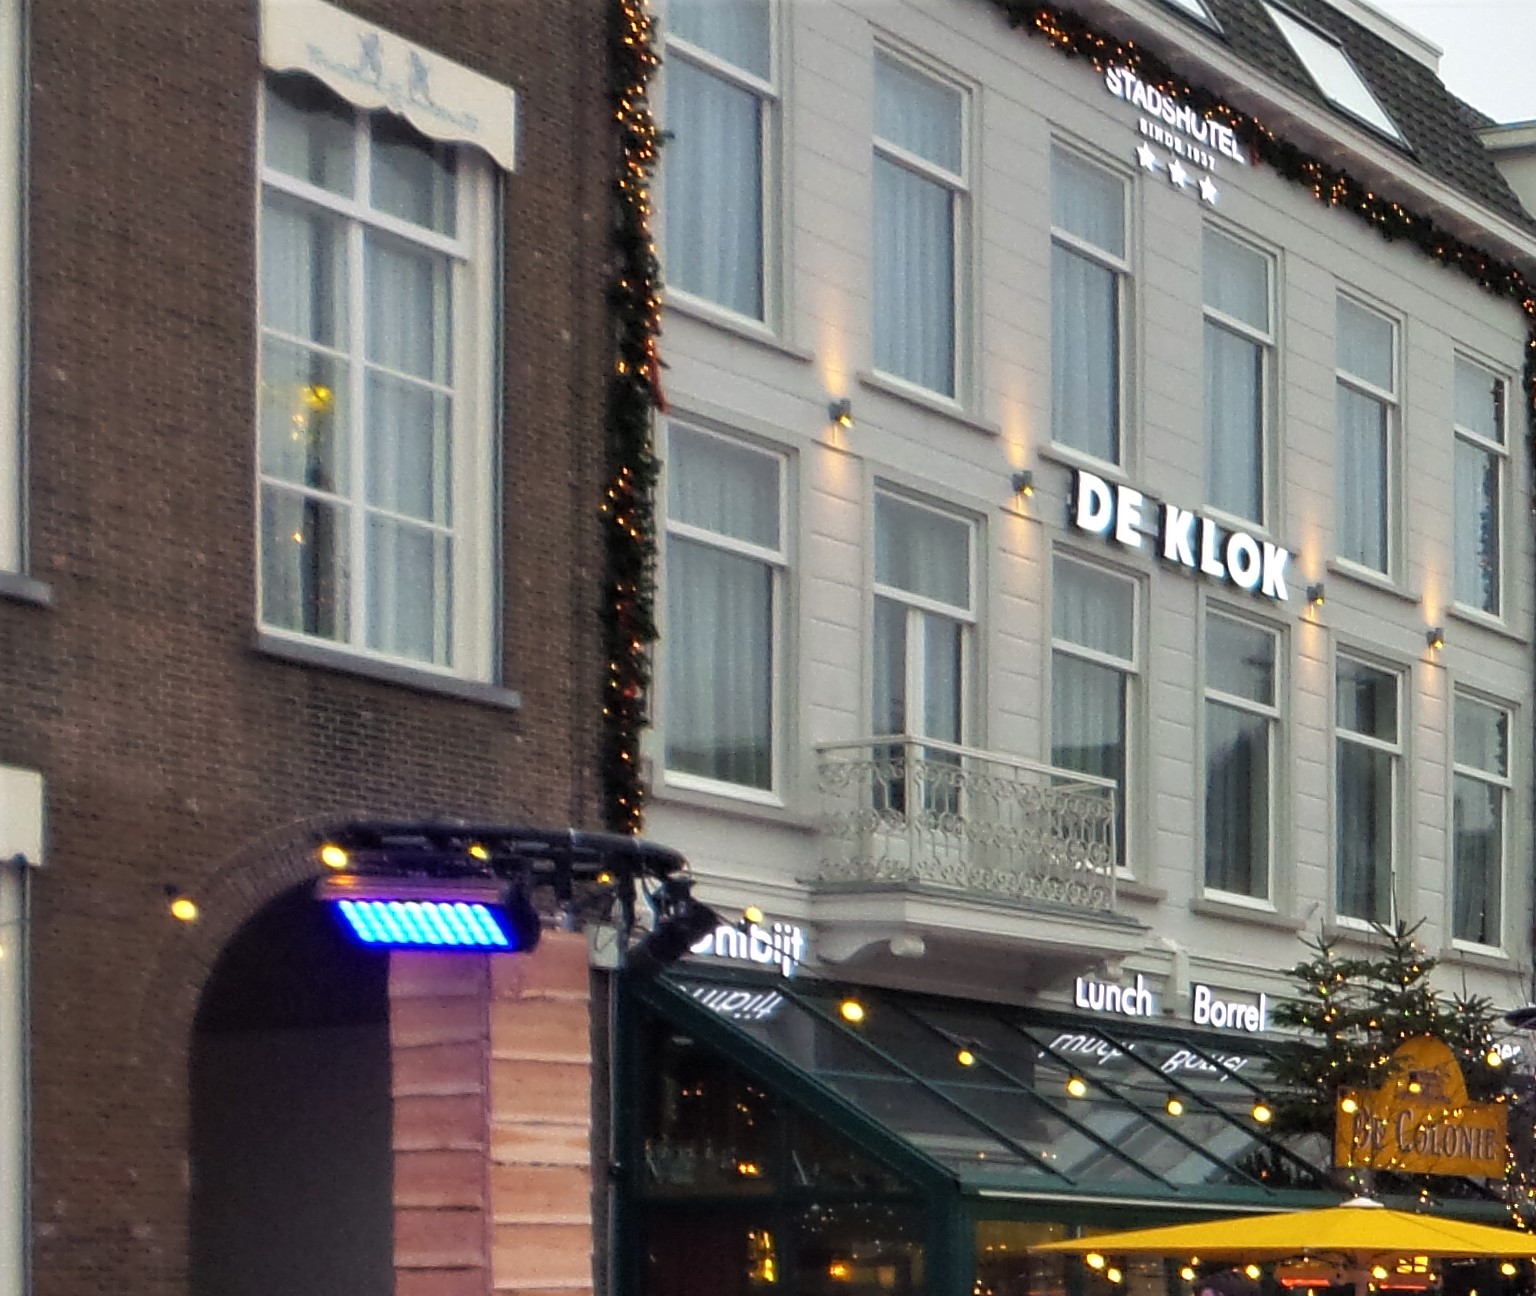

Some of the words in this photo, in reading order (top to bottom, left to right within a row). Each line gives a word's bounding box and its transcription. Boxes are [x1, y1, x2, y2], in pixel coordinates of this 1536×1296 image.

[1076, 469, 1144, 547] DE
[1163, 504, 1289, 600] KLOK
[1075, 974, 1152, 1016] Lunch
[1193, 985, 1267, 1031] Borrel
